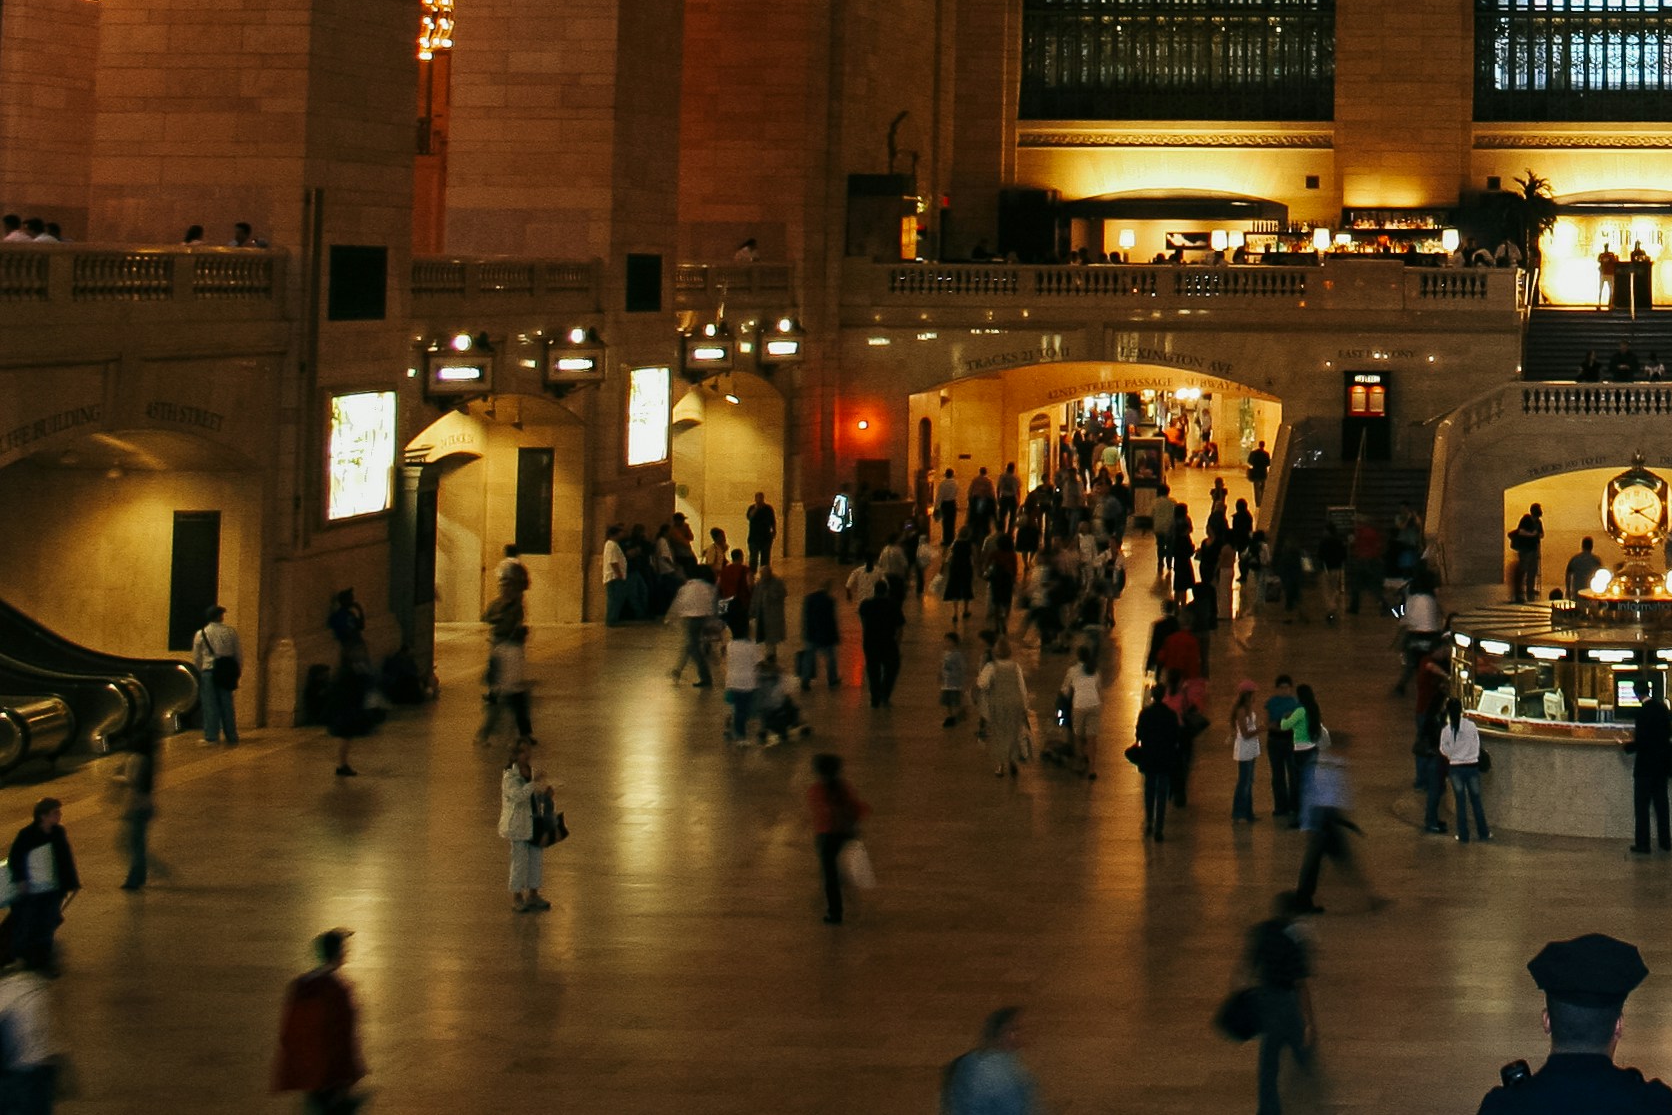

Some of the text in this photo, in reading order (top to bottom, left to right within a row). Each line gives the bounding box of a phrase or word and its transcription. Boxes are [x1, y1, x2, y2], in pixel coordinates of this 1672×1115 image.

[967, 352, 1018, 370] TRACKS
[1037, 348, 1057, 359] TO
[1120, 347, 1233, 374] LEXINGTON AVE
[1338, 349, 1362, 359] EAST
[1047, 377, 1172, 399] 42ND STREET PASSAGE
[33, 404, 101, 441] BUILDING
[179, 406, 224, 433] STREET
[1618, 601, 1672, 612] Information
